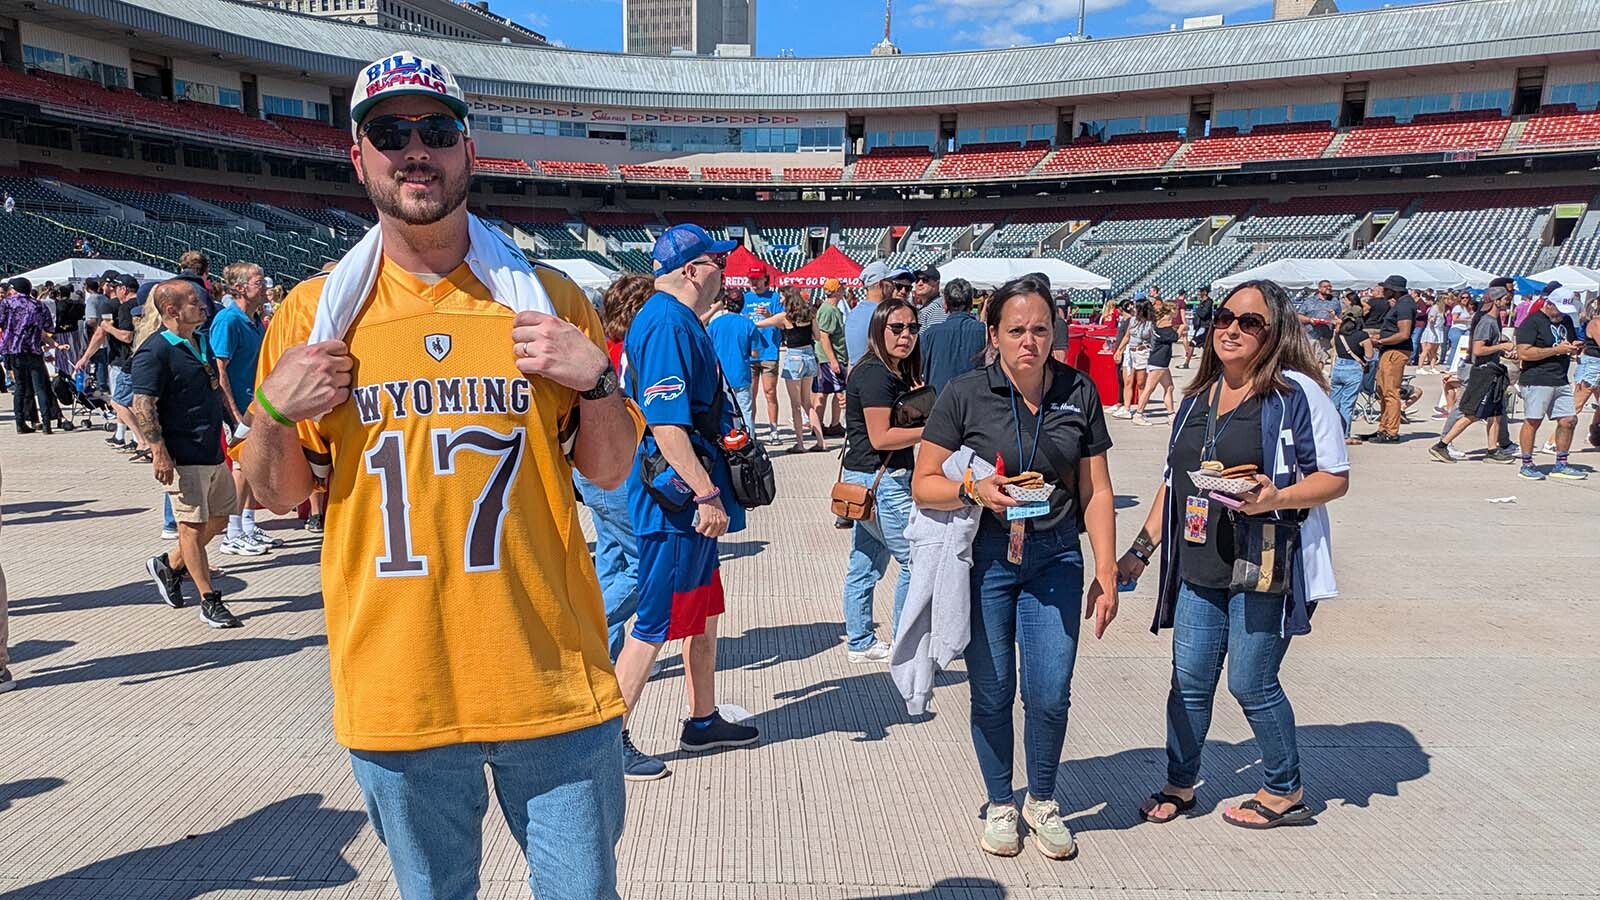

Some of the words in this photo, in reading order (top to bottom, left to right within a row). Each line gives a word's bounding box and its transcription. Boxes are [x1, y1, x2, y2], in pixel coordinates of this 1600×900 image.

[366, 73, 447, 98] BUFFALO
[725, 276, 750, 286] REDZ
[779, 277, 803, 286] LET'S
[805, 277, 818, 286] GO
[353, 376, 531, 424] WYOMING
[365, 425, 526, 577] 17
